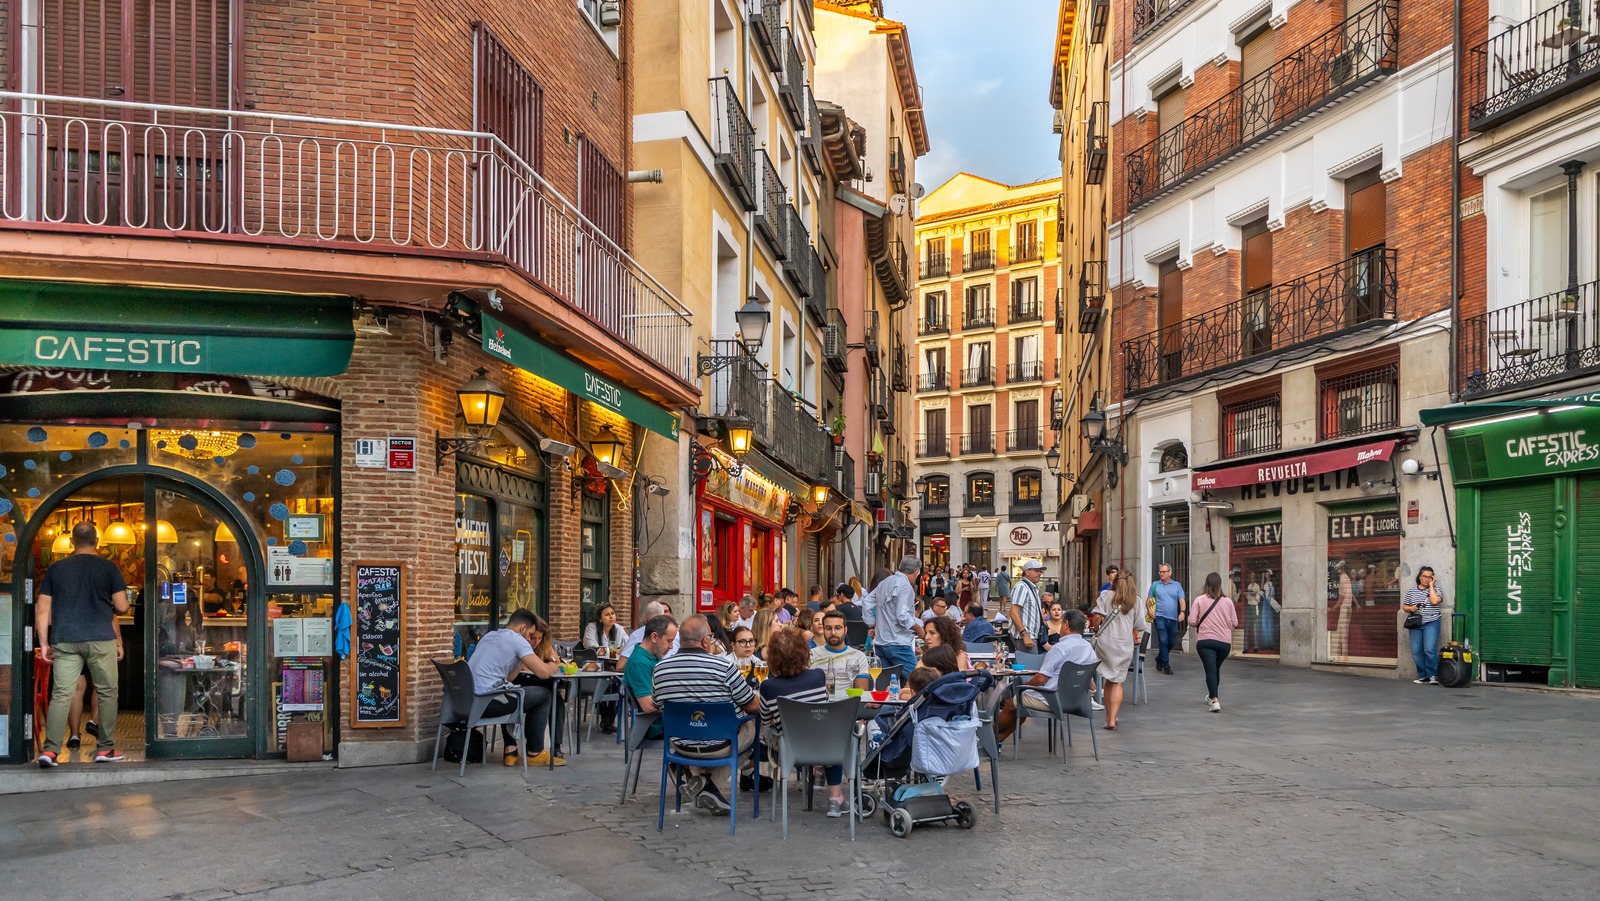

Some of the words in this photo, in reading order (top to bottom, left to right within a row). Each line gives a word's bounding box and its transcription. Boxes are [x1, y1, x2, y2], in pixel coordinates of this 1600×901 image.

[35, 335, 201, 366] CAFESTIC
[488, 338, 512, 359] Heineken
[584, 372, 622, 407] CAFESTIC
[1357, 448, 1383, 461] Mahou
[1506, 430, 1587, 458] CAFESTIC
[1545, 444, 1599, 468] EXPRESS
[1197, 476, 1216, 486] Mahou
[1258, 461, 1307, 482] REVUELTA
[1012, 530, 1029, 541] Rin
[1235, 532, 1253, 543] VINOS
[1254, 524, 1282, 546] REV
[1331, 514, 1375, 539] ELTA
[1519, 512, 1535, 572] EXPRESS
[359, 567, 398, 576] CAFESTIC
[459, 549, 488, 576] FIESTA
[1507, 524, 1523, 615] CAFESTIC
[375, 582, 394, 592] BAR
[982, 574, 989, 584] 12
